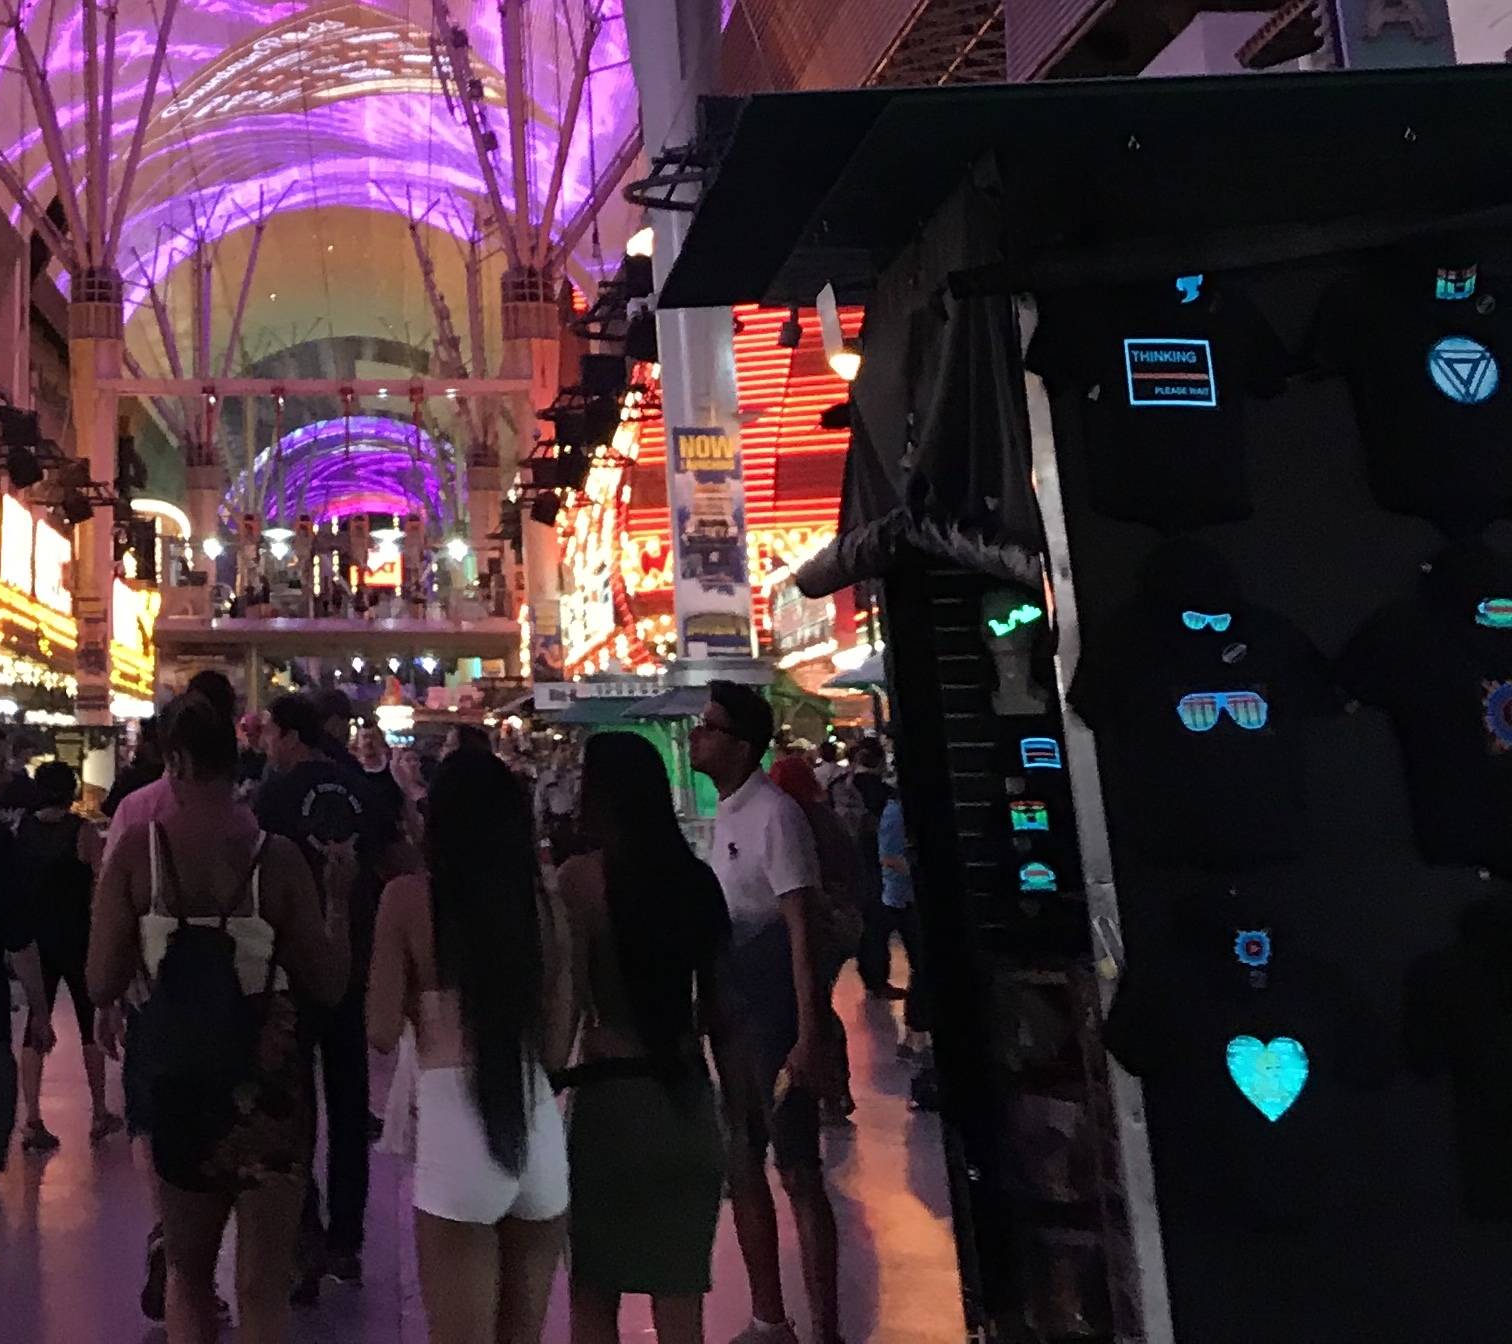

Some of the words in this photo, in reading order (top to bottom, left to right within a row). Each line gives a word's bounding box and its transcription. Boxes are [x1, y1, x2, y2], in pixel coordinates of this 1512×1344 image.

[1132, 350, 1197, 363] THINKING
[1155, 387, 1187, 395] PLEASE
[1189, 387, 1209, 395] WAIT
[679, 434, 735, 459] NOW
